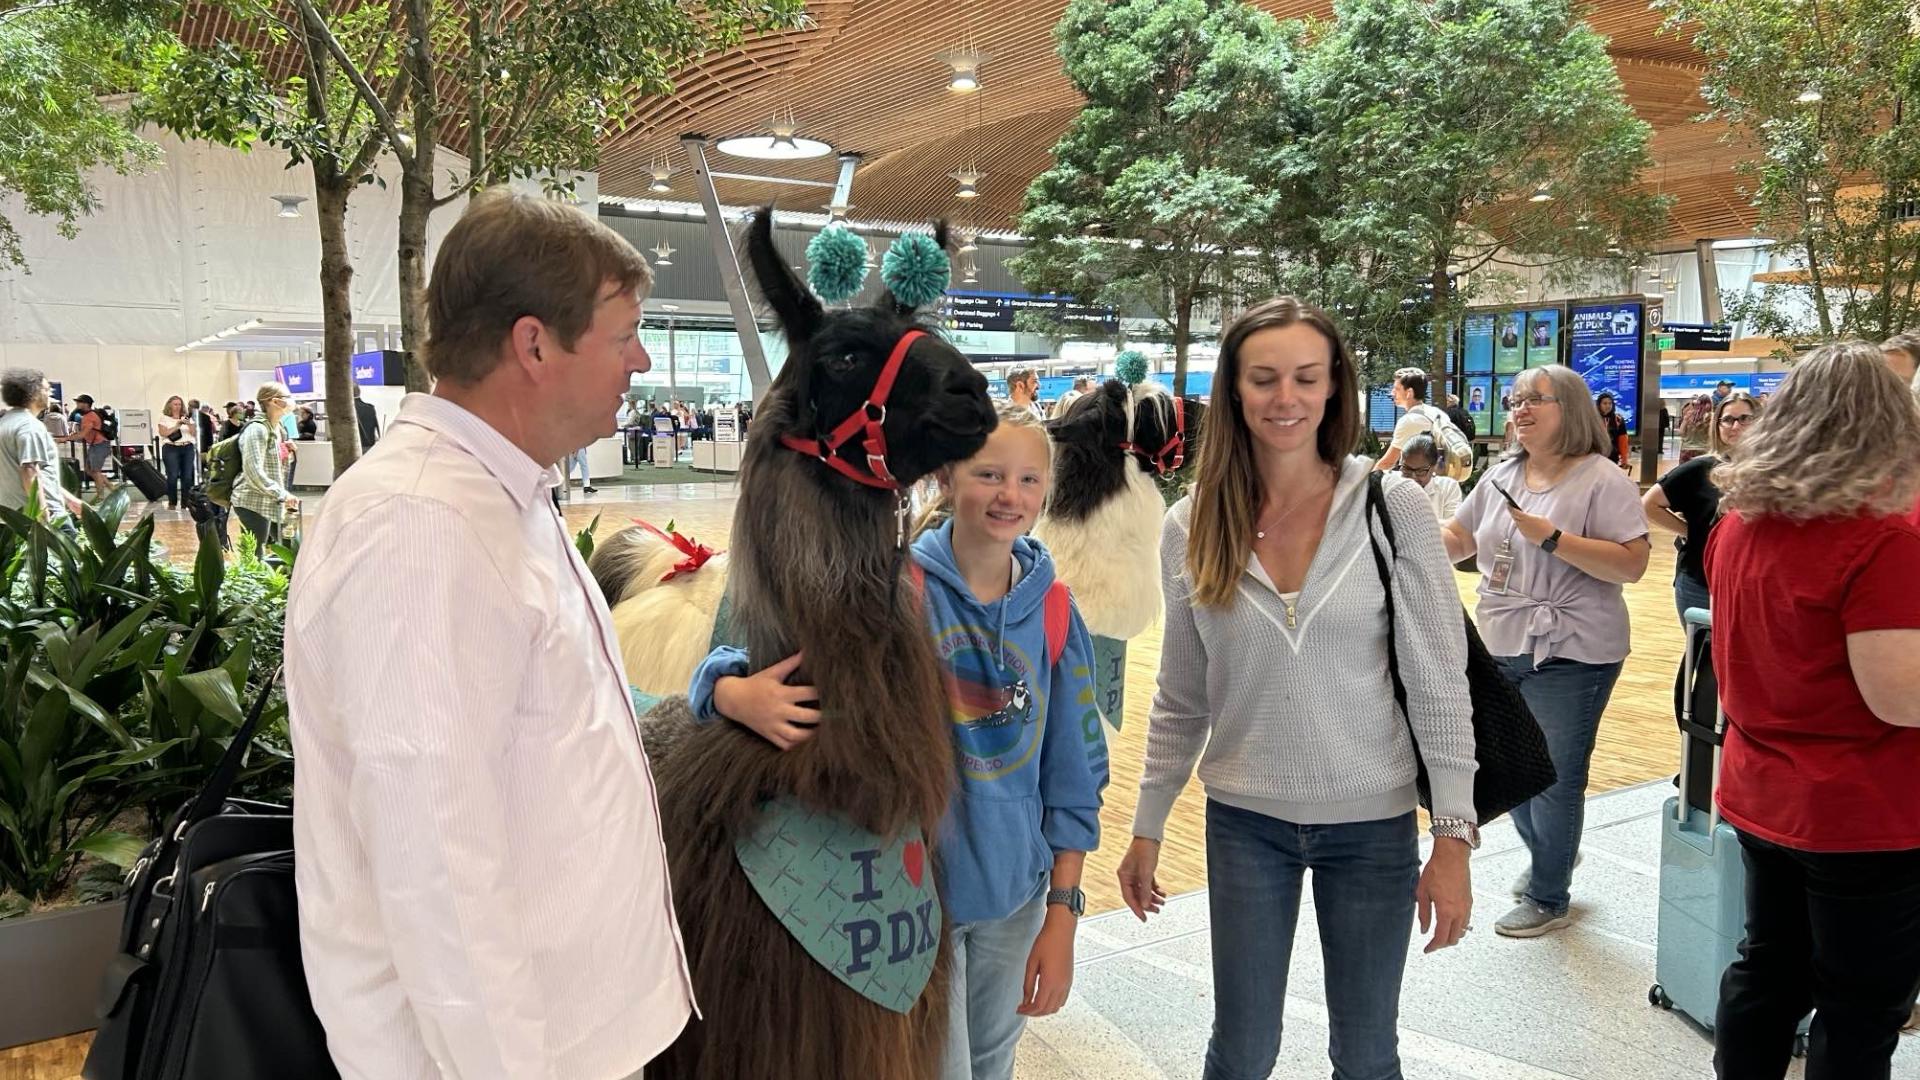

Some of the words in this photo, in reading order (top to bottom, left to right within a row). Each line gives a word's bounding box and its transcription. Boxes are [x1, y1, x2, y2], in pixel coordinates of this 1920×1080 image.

[1573, 311, 1612, 321] ANIMALS
[1573, 322, 1584, 330] AT
[851, 850, 883, 903] I
[843, 900, 936, 976] PDX
